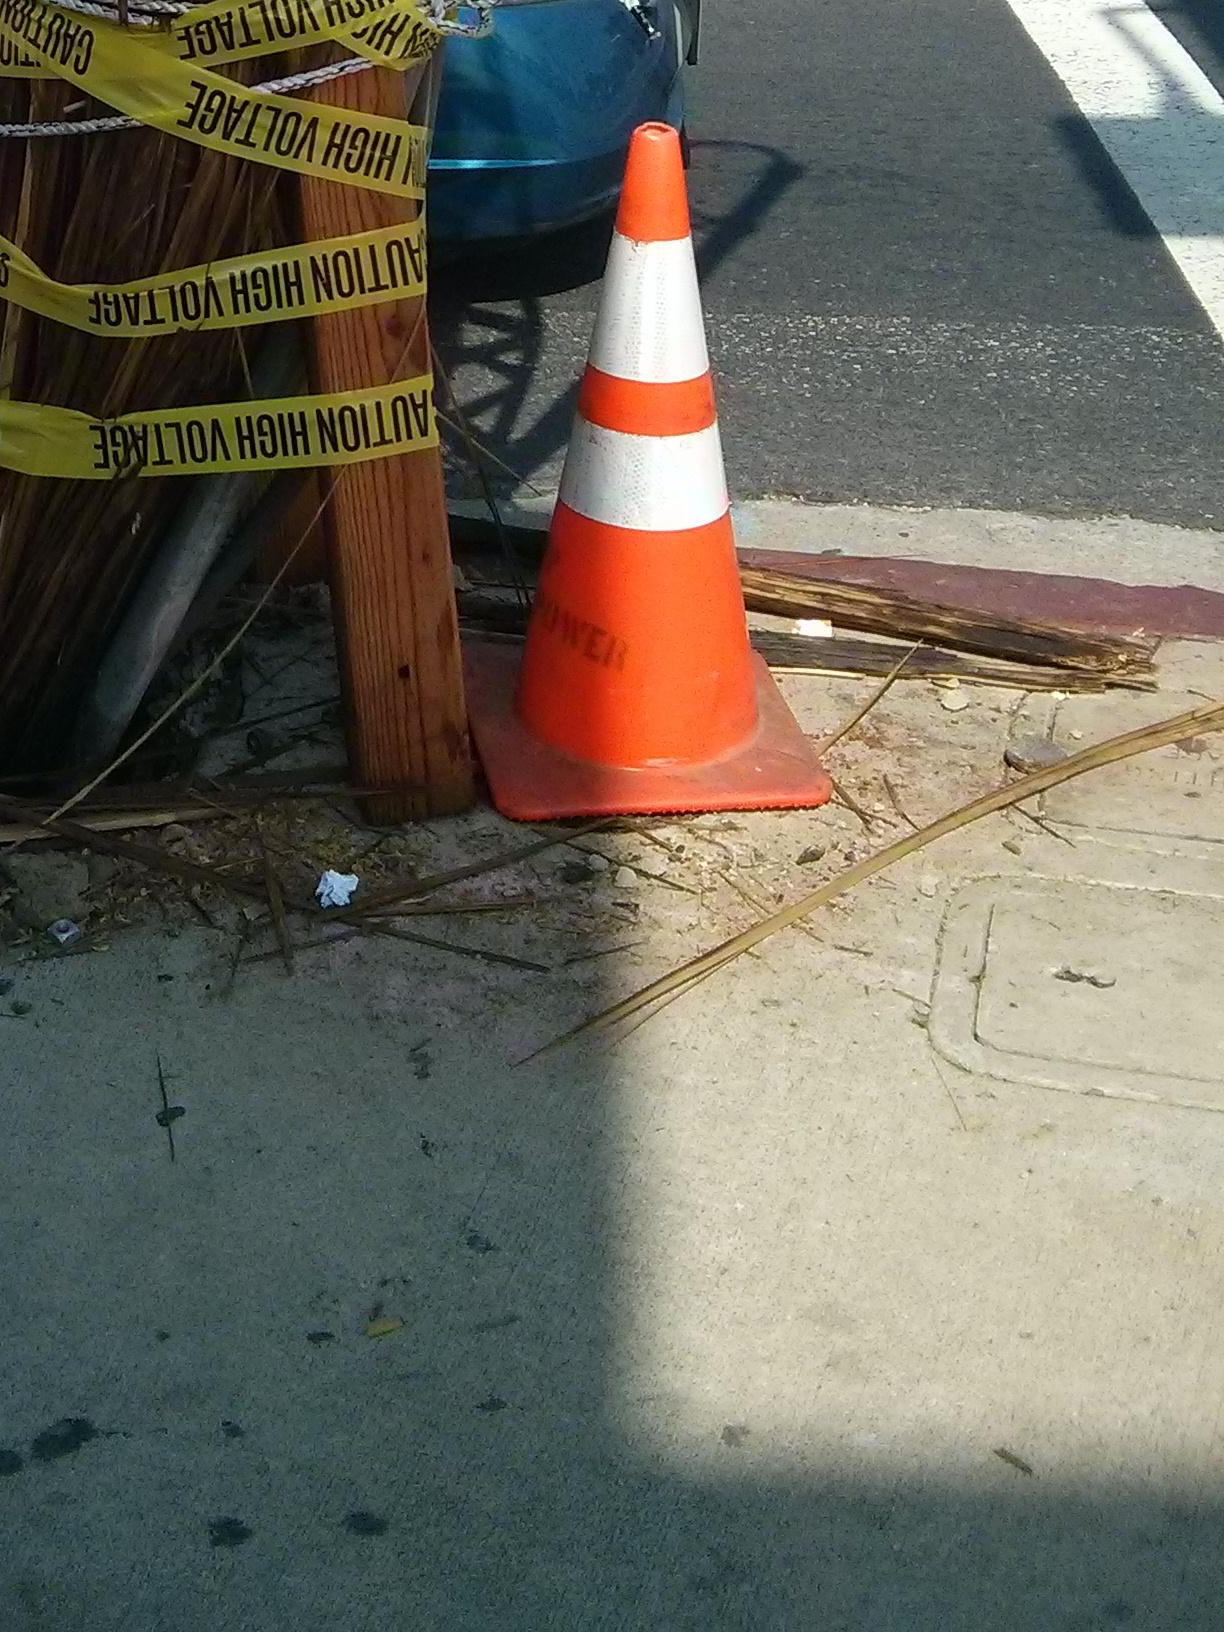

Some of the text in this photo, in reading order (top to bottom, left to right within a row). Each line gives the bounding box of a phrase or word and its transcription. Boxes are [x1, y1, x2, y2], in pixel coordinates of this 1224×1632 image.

[176, 79, 320, 164] VOLTAGE
[321, 121, 402, 183] HIGH
[88, 275, 225, 328] VOLTAGE
[229, 259, 306, 315] HIGH
[89, 389, 429, 470] AUTION HIGH VOLTAGE
